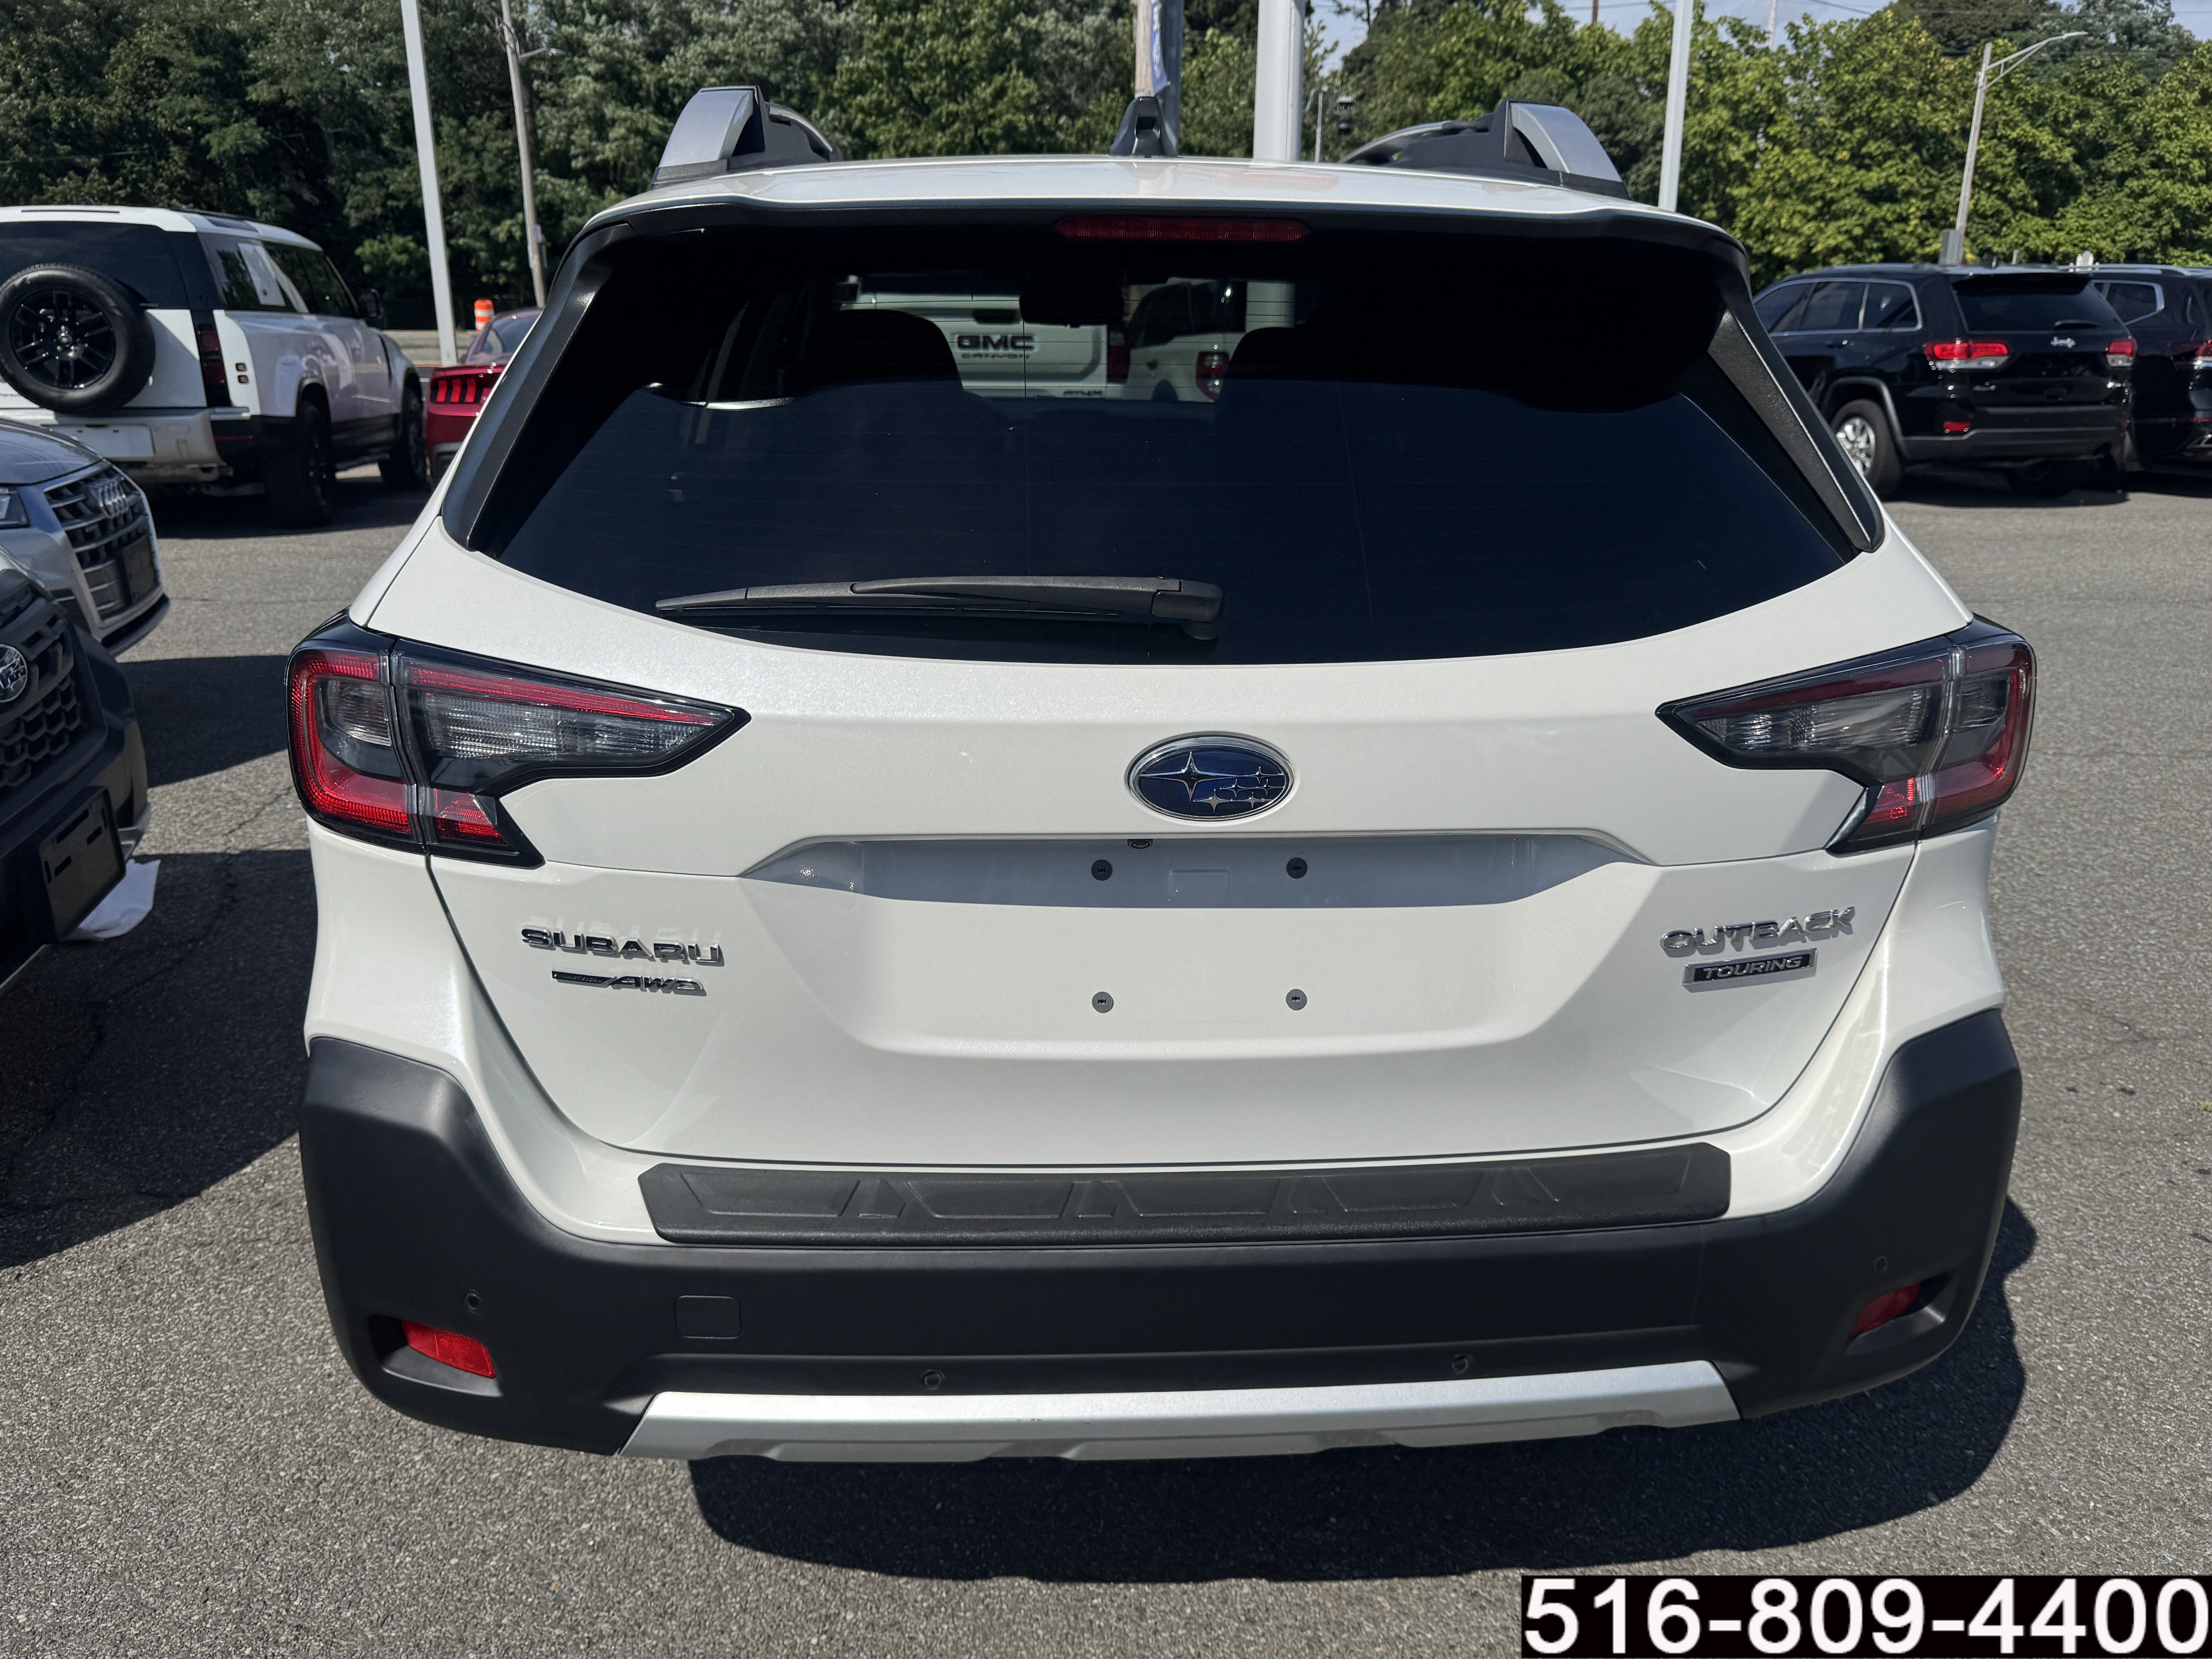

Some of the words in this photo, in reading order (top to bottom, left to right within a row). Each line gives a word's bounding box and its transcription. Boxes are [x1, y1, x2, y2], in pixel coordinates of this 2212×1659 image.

[957, 335, 1034, 349] GMC
[1660, 906, 1855, 952] OUTBACK
[521, 928, 723, 964] SUBARU
[1703, 958, 1802, 979] TOURING
[612, 975, 705, 994] AWD
